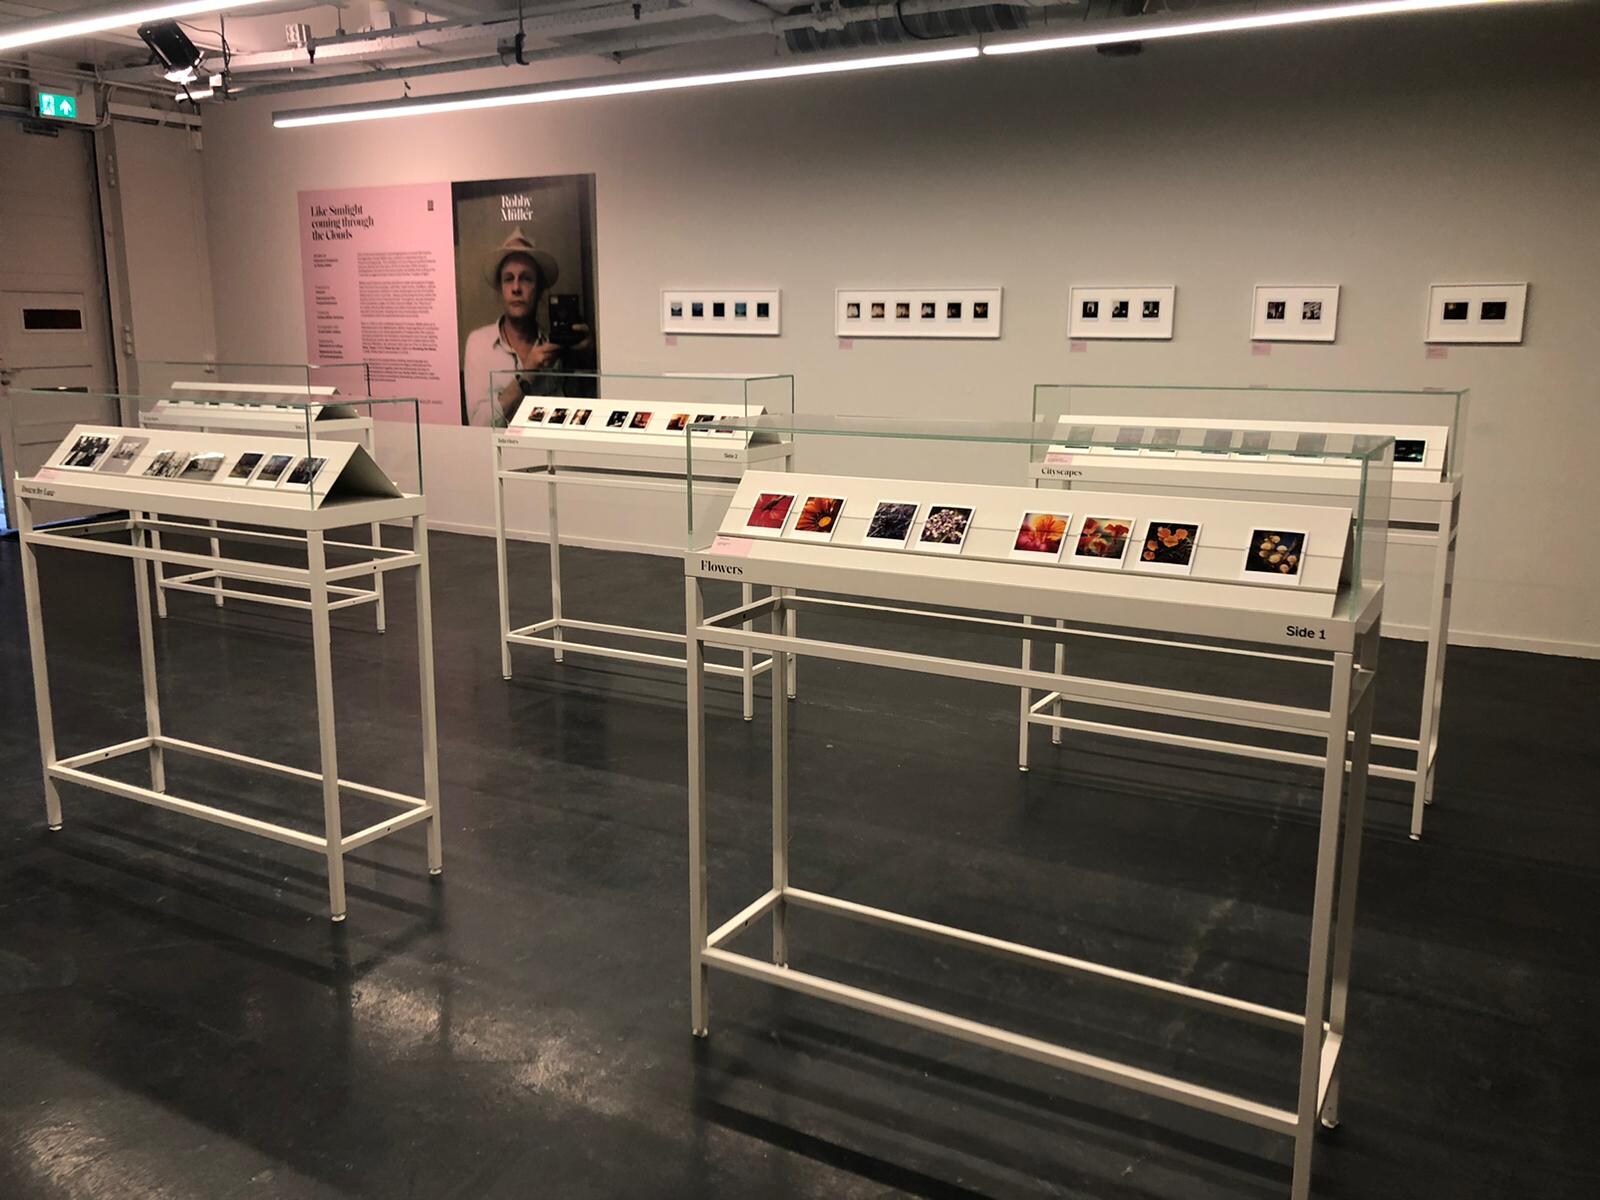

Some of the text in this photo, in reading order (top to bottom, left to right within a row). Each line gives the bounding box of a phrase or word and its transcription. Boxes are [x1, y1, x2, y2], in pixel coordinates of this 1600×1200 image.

[501, 194, 532, 209] Robby
[310, 204, 363, 217] Like Sunlight
[501, 208, 533, 222] Müller
[311, 216, 375, 230] coming through
[312, 229, 353, 241] the Clouds
[1041, 467, 1083, 478] Cityscapes
[700, 559, 744, 576] Flowers
[1286, 625, 1326, 640] Side 1
